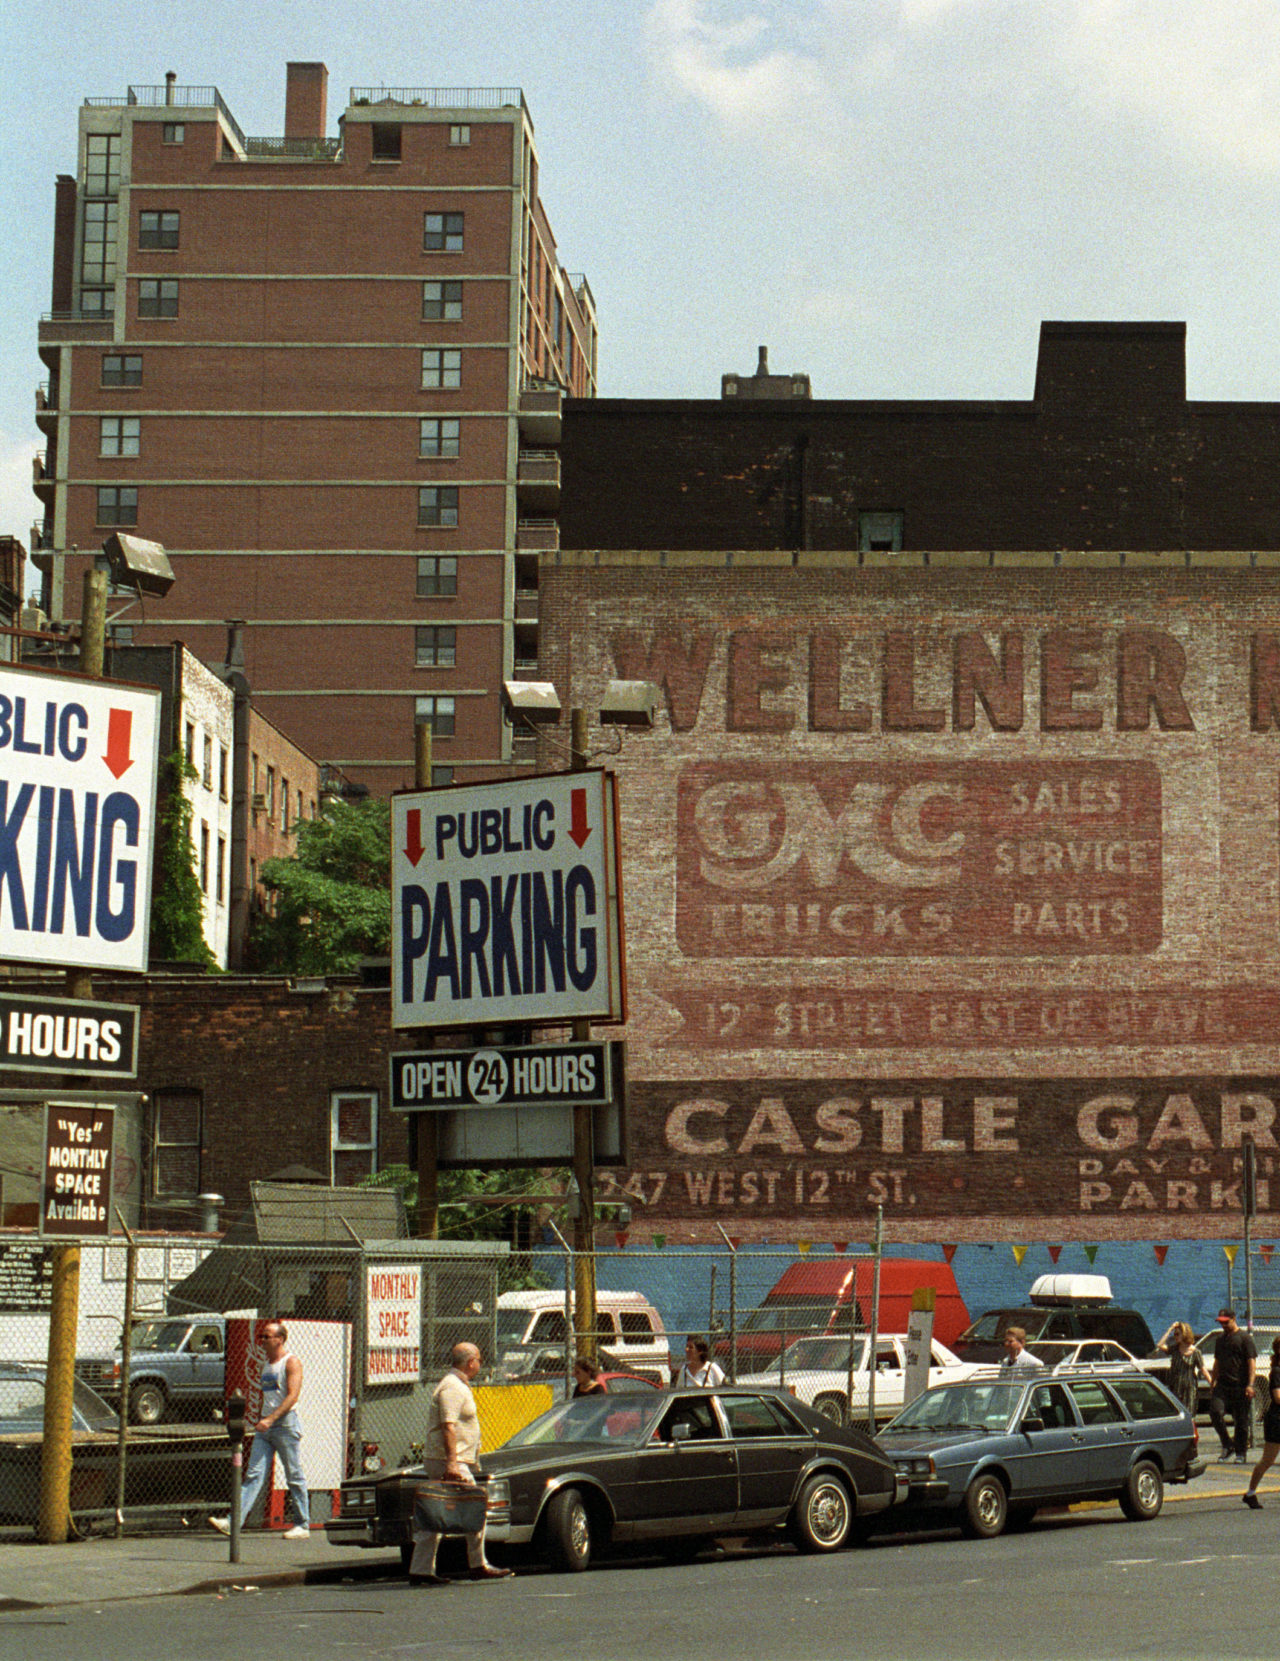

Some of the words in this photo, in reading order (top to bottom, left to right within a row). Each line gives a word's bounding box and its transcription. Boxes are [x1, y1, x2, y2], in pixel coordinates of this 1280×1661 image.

[608, 629, 1197, 733] WELLNER
[1010, 780, 1122, 815] SALES
[436, 799, 556, 860] PUBLIC
[694, 780, 966, 889] GMC
[994, 839, 1150, 876] SERVICE
[402, 864, 597, 1004] PARKING
[708, 902, 953, 938] TRUCKS
[1012, 900, 1130, 937] PARTS
[8, 1012, 122, 1063] HOURS
[402, 1060, 462, 1100] OPEN
[473, 1058, 504, 1097] 24
[513, 1053, 596, 1095] HOURS
[664, 1096, 1020, 1156] CASTLE
[48, 1146, 109, 1170] MONTHLY
[1079, 1156, 1168, 1176] DAY
[1188, 1156, 1212, 1175] &
[55, 1172, 102, 1195] SPACE
[683, 1170, 781, 1205] WEST
[866, 1169, 916, 1205] ST.
[46, 1198, 107, 1221] Availabe
[371, 1273, 419, 1300] MONTHLY
[379, 1311, 410, 1338] SPACE
[369, 1347, 420, 1375] AVAILABLE
